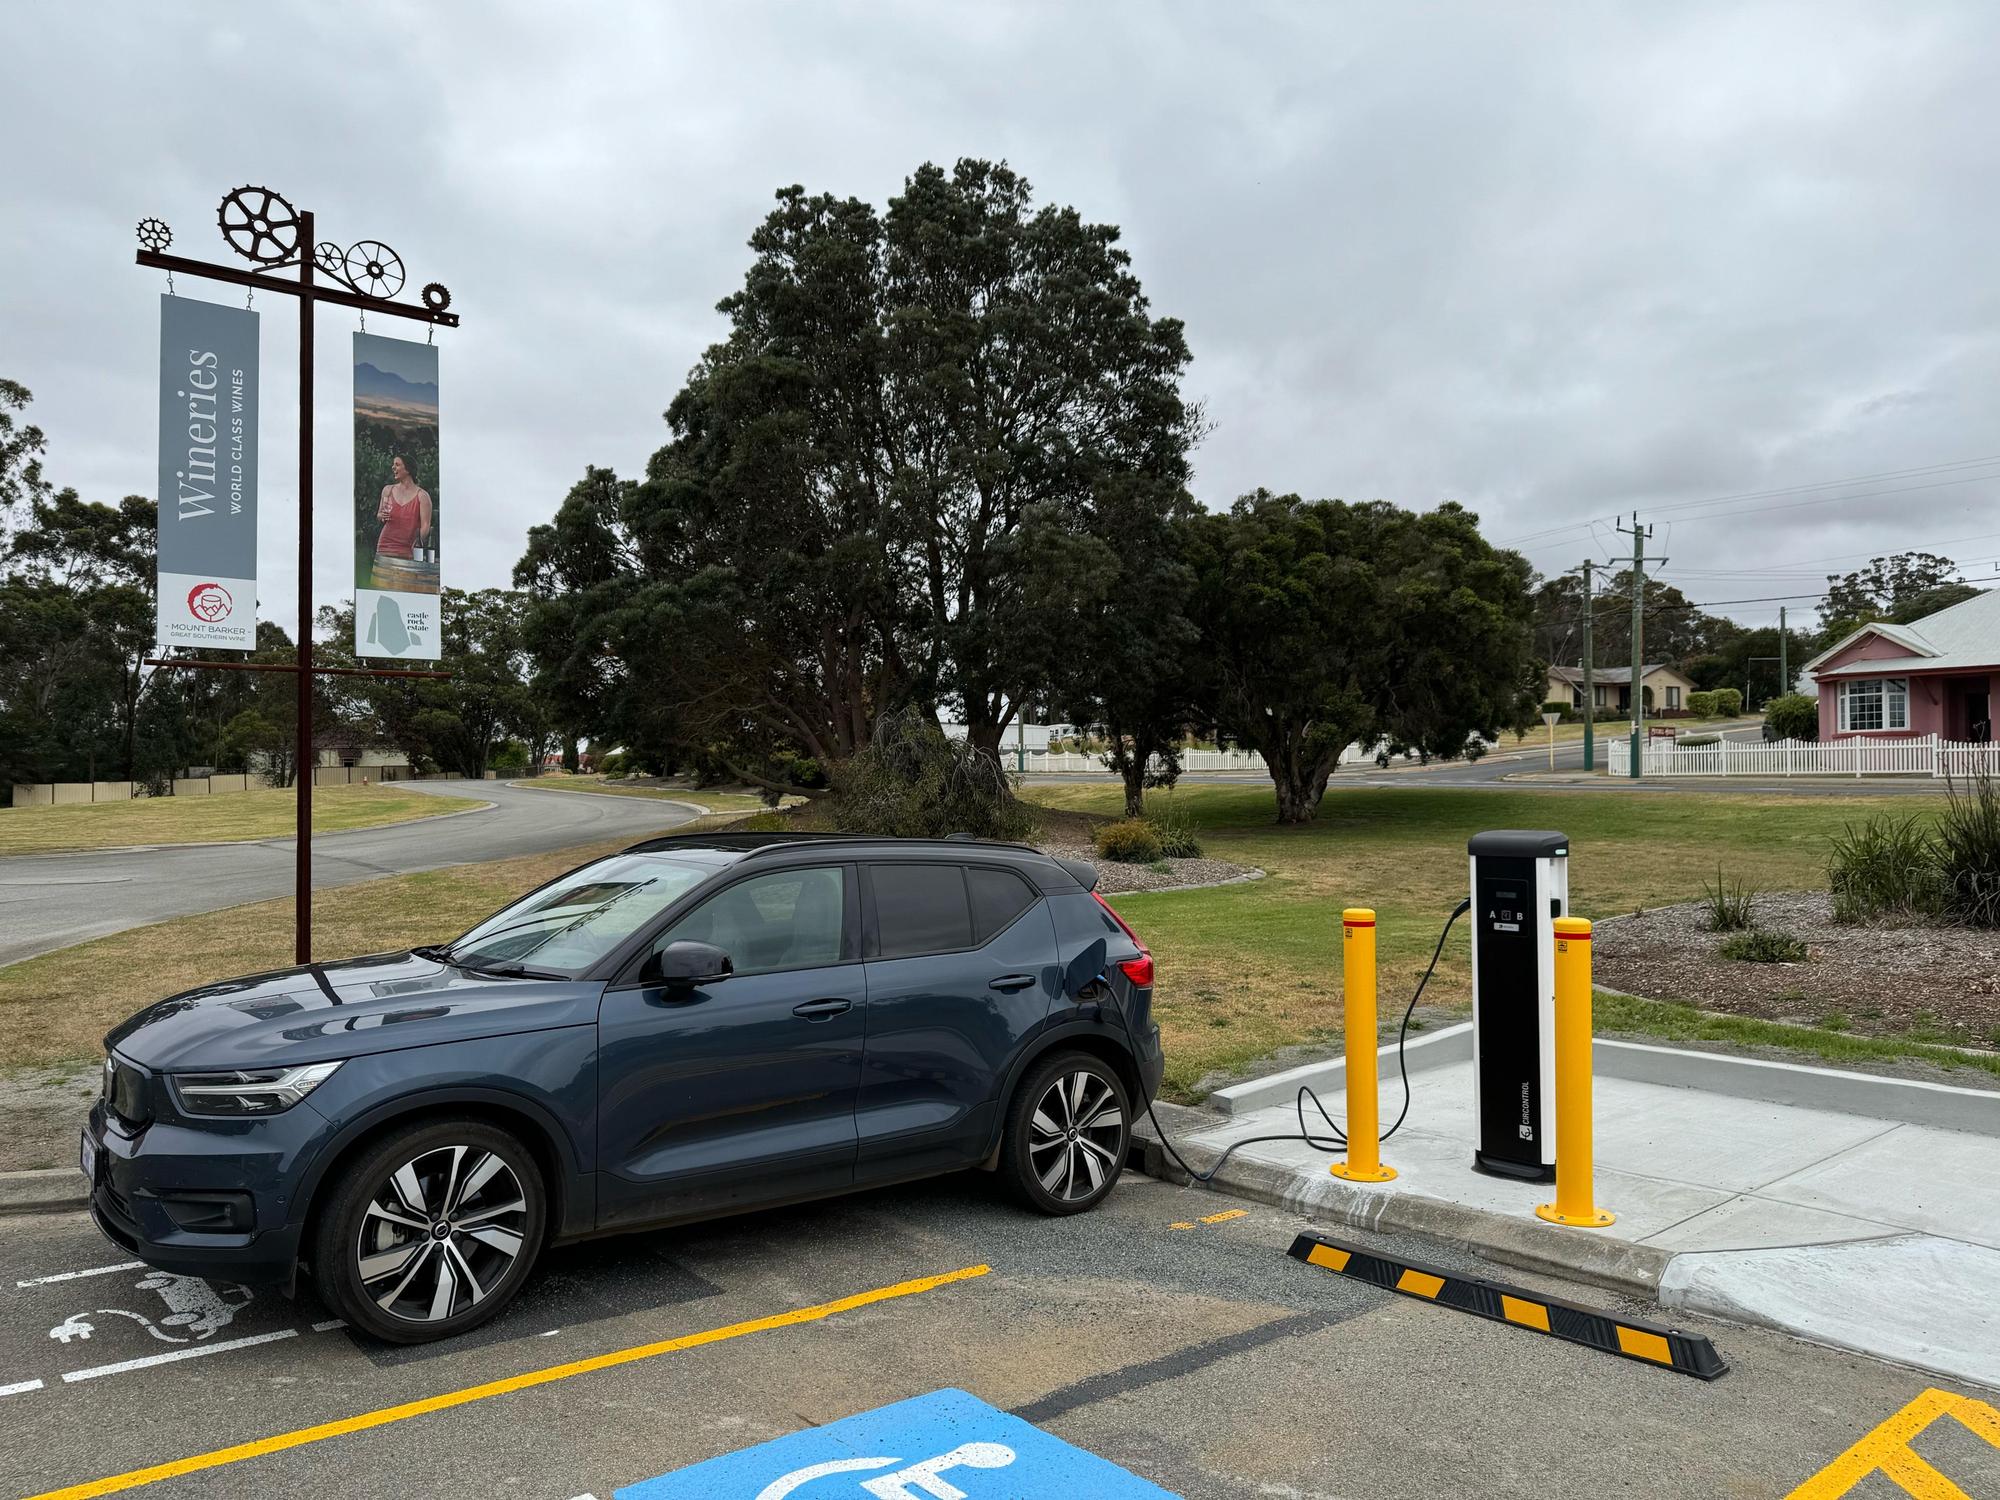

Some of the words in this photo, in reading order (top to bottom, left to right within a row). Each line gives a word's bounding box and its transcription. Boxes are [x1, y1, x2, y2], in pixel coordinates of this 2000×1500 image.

[232, 368, 244, 413] WINES
[176, 349, 218, 521] Wineries
[231, 418, 243, 461] CLASS
[230, 465, 243, 515] WORLD
[171, 624, 206, 632] MOUNT
[208, 626, 246, 634] BARKER
[1489, 910, 1496, 918] A
[1522, 1082, 1530, 1124] CIRCONTROL
